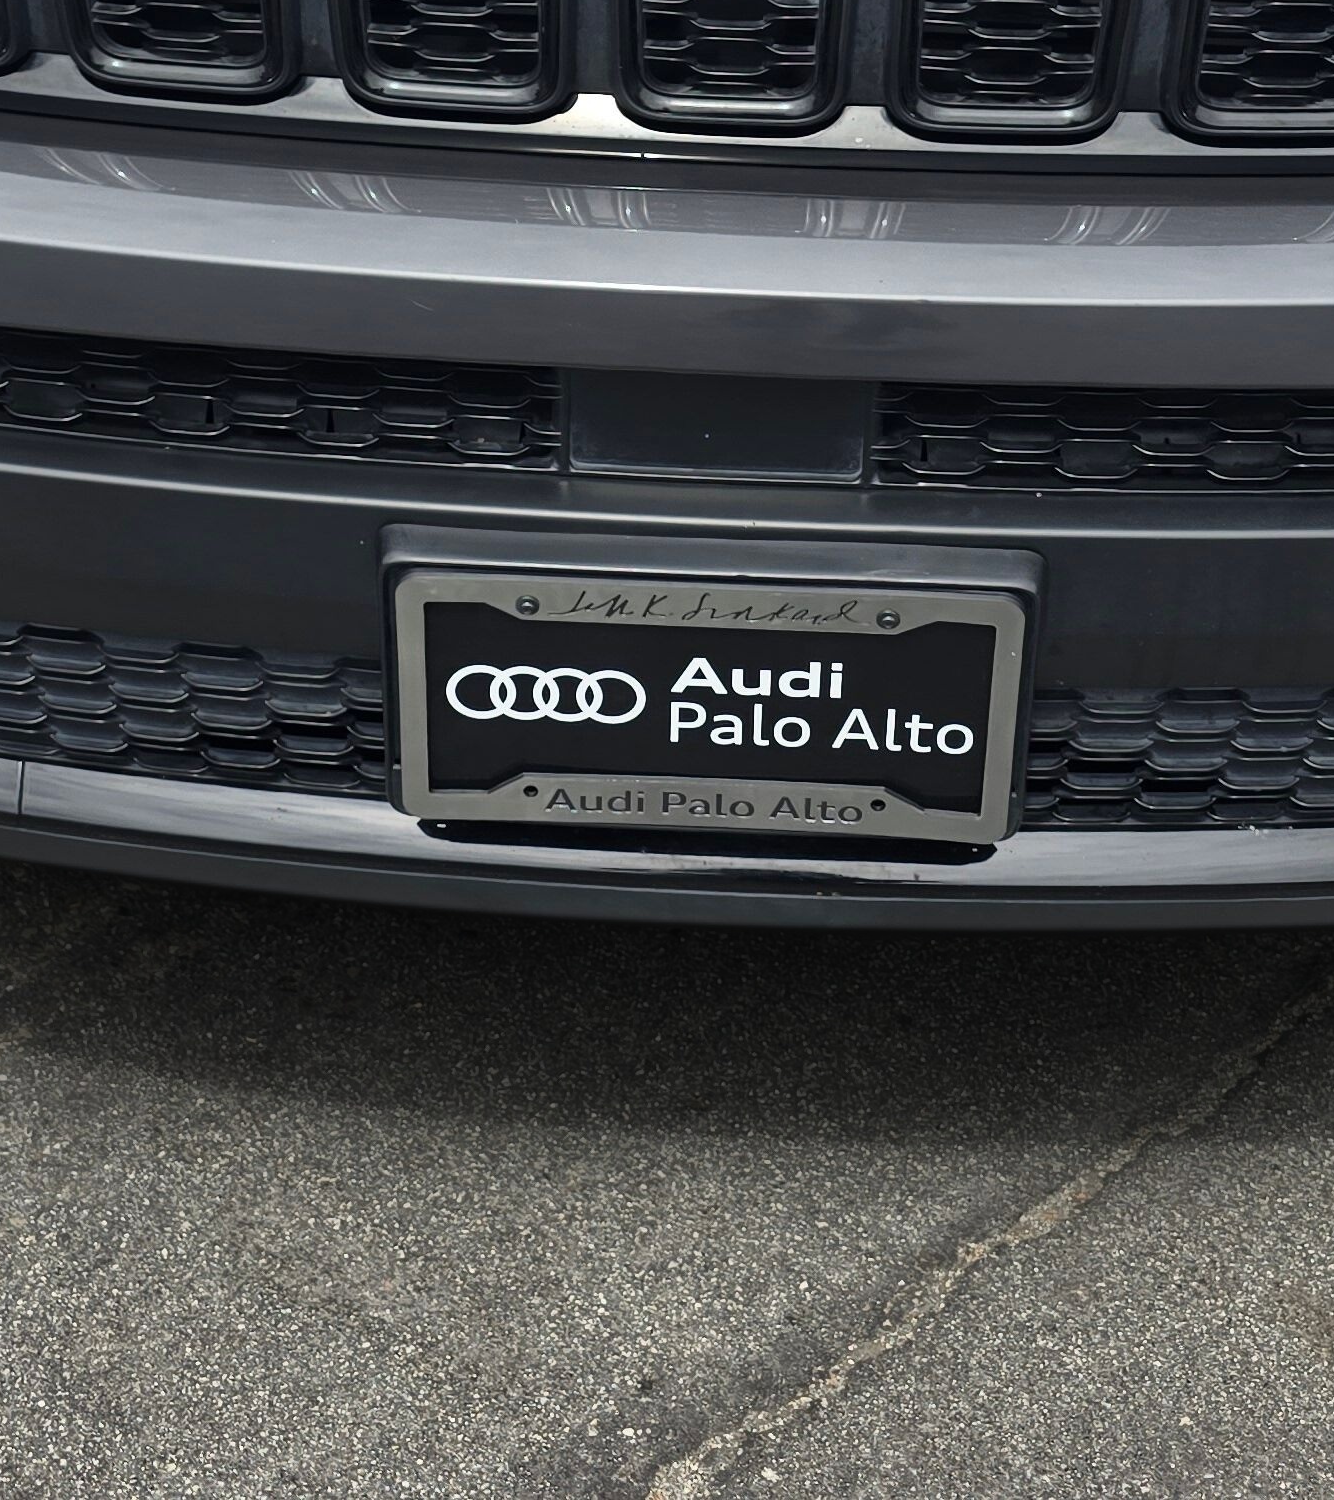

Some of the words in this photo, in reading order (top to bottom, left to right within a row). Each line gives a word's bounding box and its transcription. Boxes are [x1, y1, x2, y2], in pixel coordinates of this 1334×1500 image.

[670, 657, 844, 699] Audi
[669, 701, 812, 748] Palo
[831, 708, 975, 755] Alto
[545, 788, 645, 813] Audi
[661, 791, 755, 817] Palo
[769, 796, 864, 824] Alto
